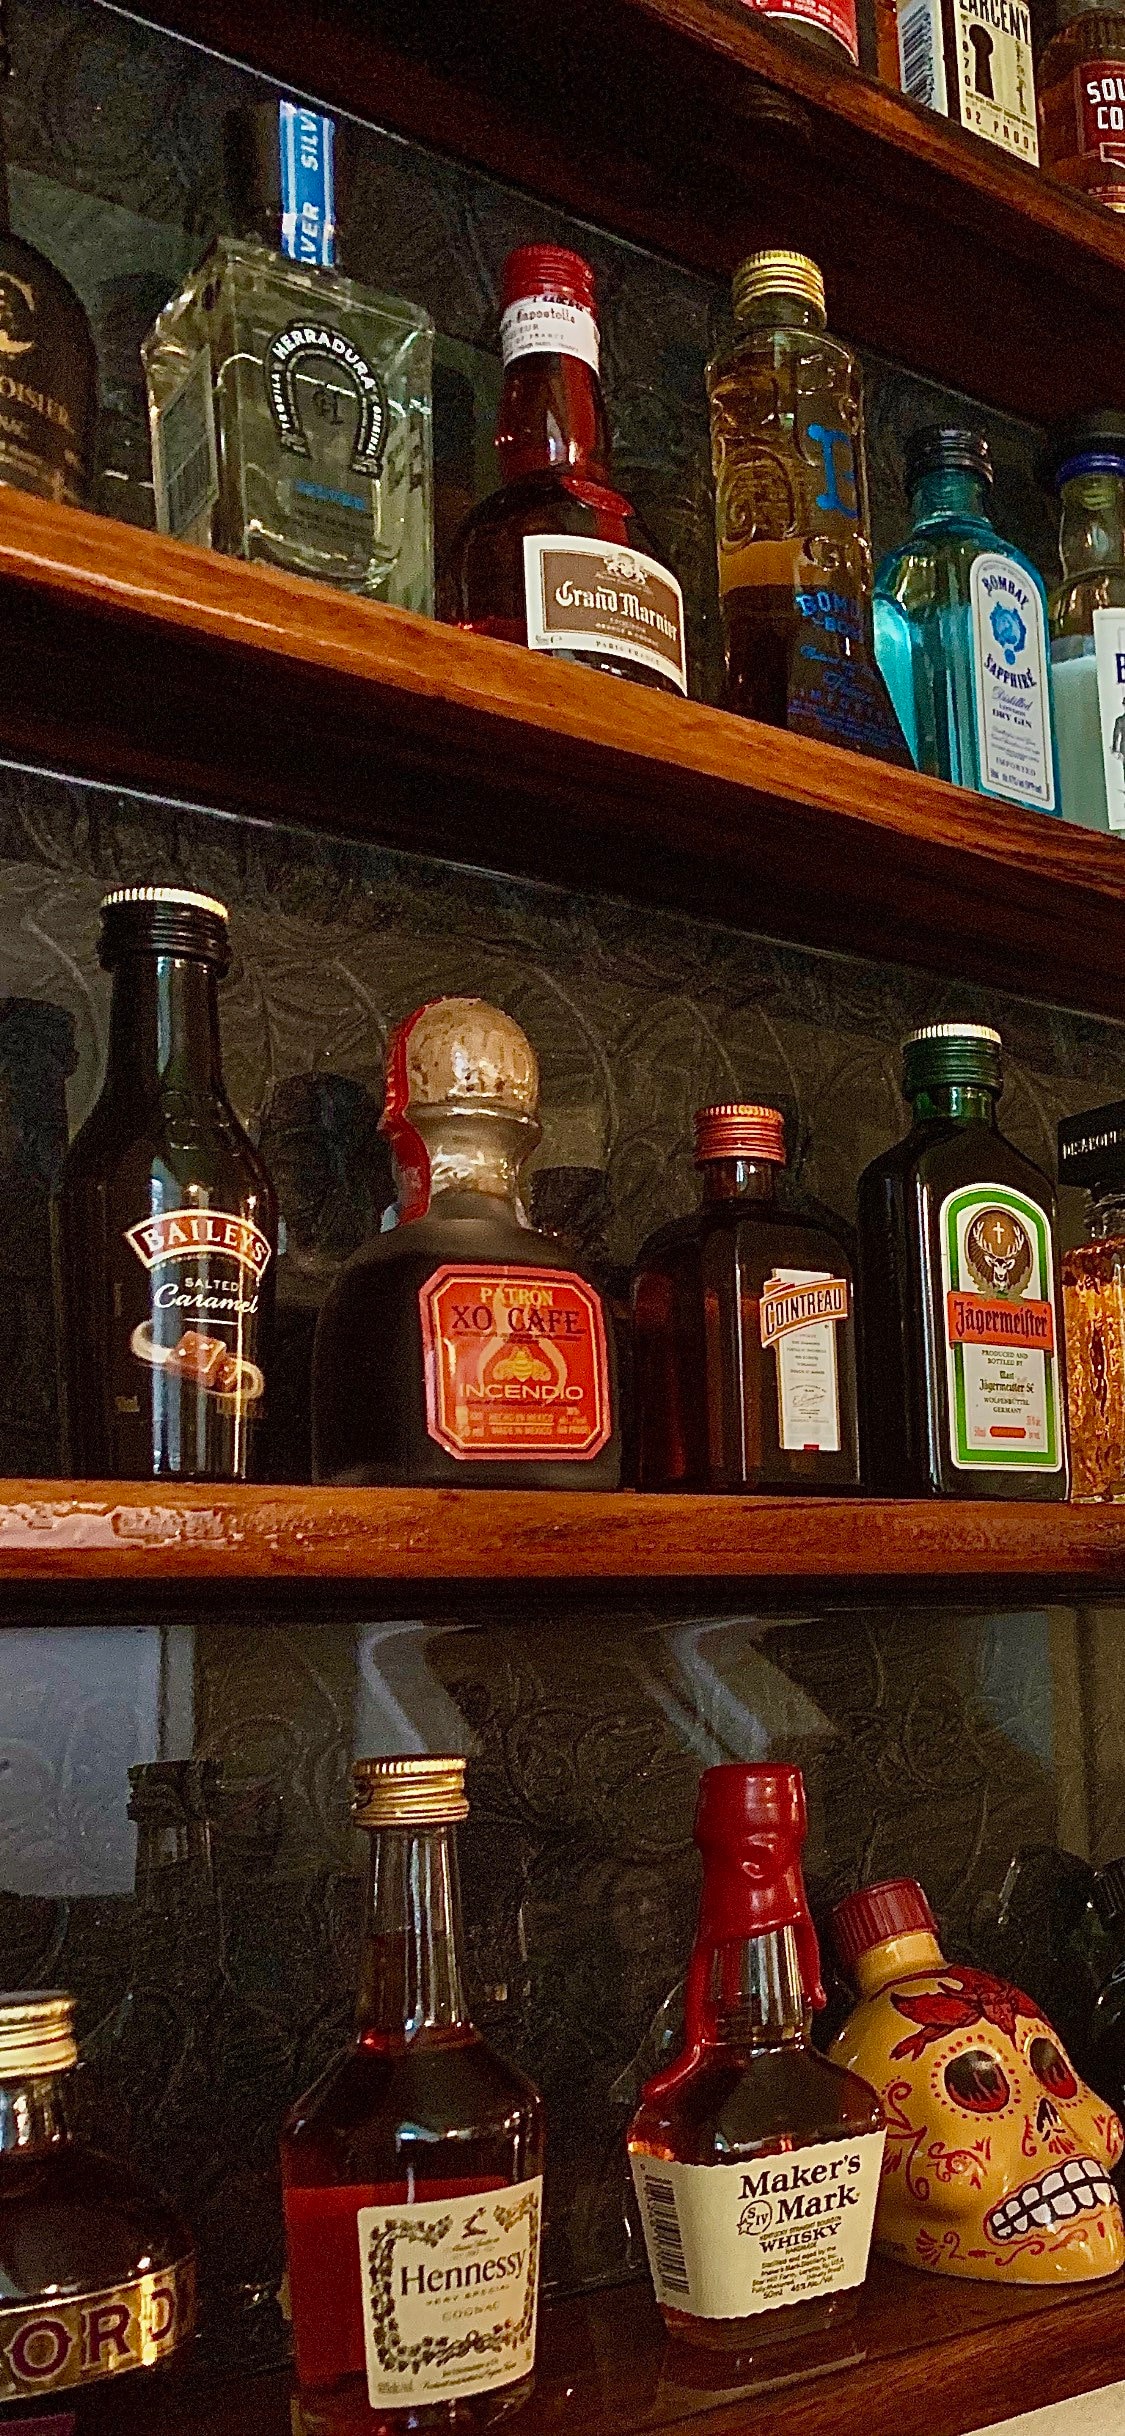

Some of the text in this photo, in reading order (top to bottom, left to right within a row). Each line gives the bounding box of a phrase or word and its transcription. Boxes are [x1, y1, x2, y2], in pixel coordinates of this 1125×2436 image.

[272, 328, 376, 390] HERRADURA
[271, 373, 291, 430] TEQUILA
[555, 580, 618, 614] Grand
[619, 592, 678, 642] Marnier
[981, 574, 1030, 611] BOMBAY
[983, 652, 1038, 691] SAPPHIRE
[991, 707, 1033, 729] DRY GIN
[141, 1219, 266, 1262] BAILEYS
[154, 1282, 259, 1315] Caramel
[185, 1277, 240, 1293] SALTED
[451, 1305, 492, 1331] XO
[765, 1288, 842, 1336] COINTREAU
[955, 1301, 1048, 1338] Jägermeister
[458, 1383, 584, 1401] INCENDIO
[738, 2156, 860, 2199] Maker's
[758, 2222, 842, 2253] WHISKY
[401, 2249, 527, 2297] Hennessy
